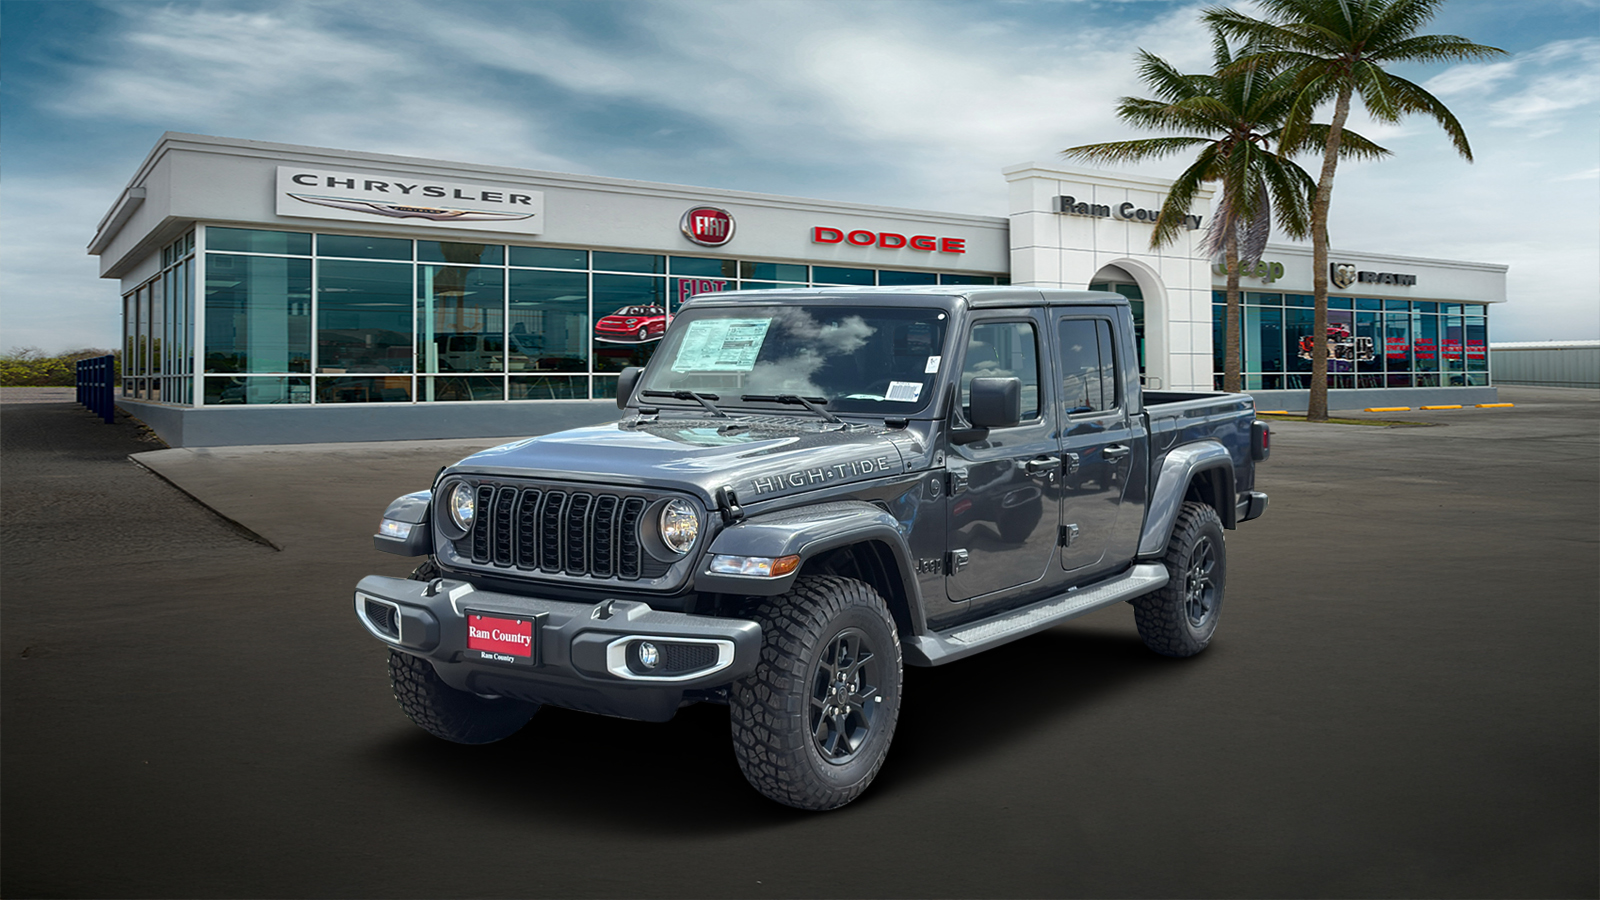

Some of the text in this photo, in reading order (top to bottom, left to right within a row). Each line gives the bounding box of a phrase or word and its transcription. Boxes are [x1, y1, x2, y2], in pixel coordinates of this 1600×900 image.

[292, 174, 532, 205] CHRYSLER
[1054, 195, 1203, 230] Ram Coury
[695, 215, 728, 237] FIAT
[812, 226, 967, 254] DODGE
[1358, 271, 1417, 286] RAM
[678, 279, 727, 303] FIAT
[754, 456, 890, 495] HIGH TIDE
[915, 557, 943, 575] Jeep
[469, 626, 532, 647] Ram Country
[481, 651, 514, 663] Ram Country
